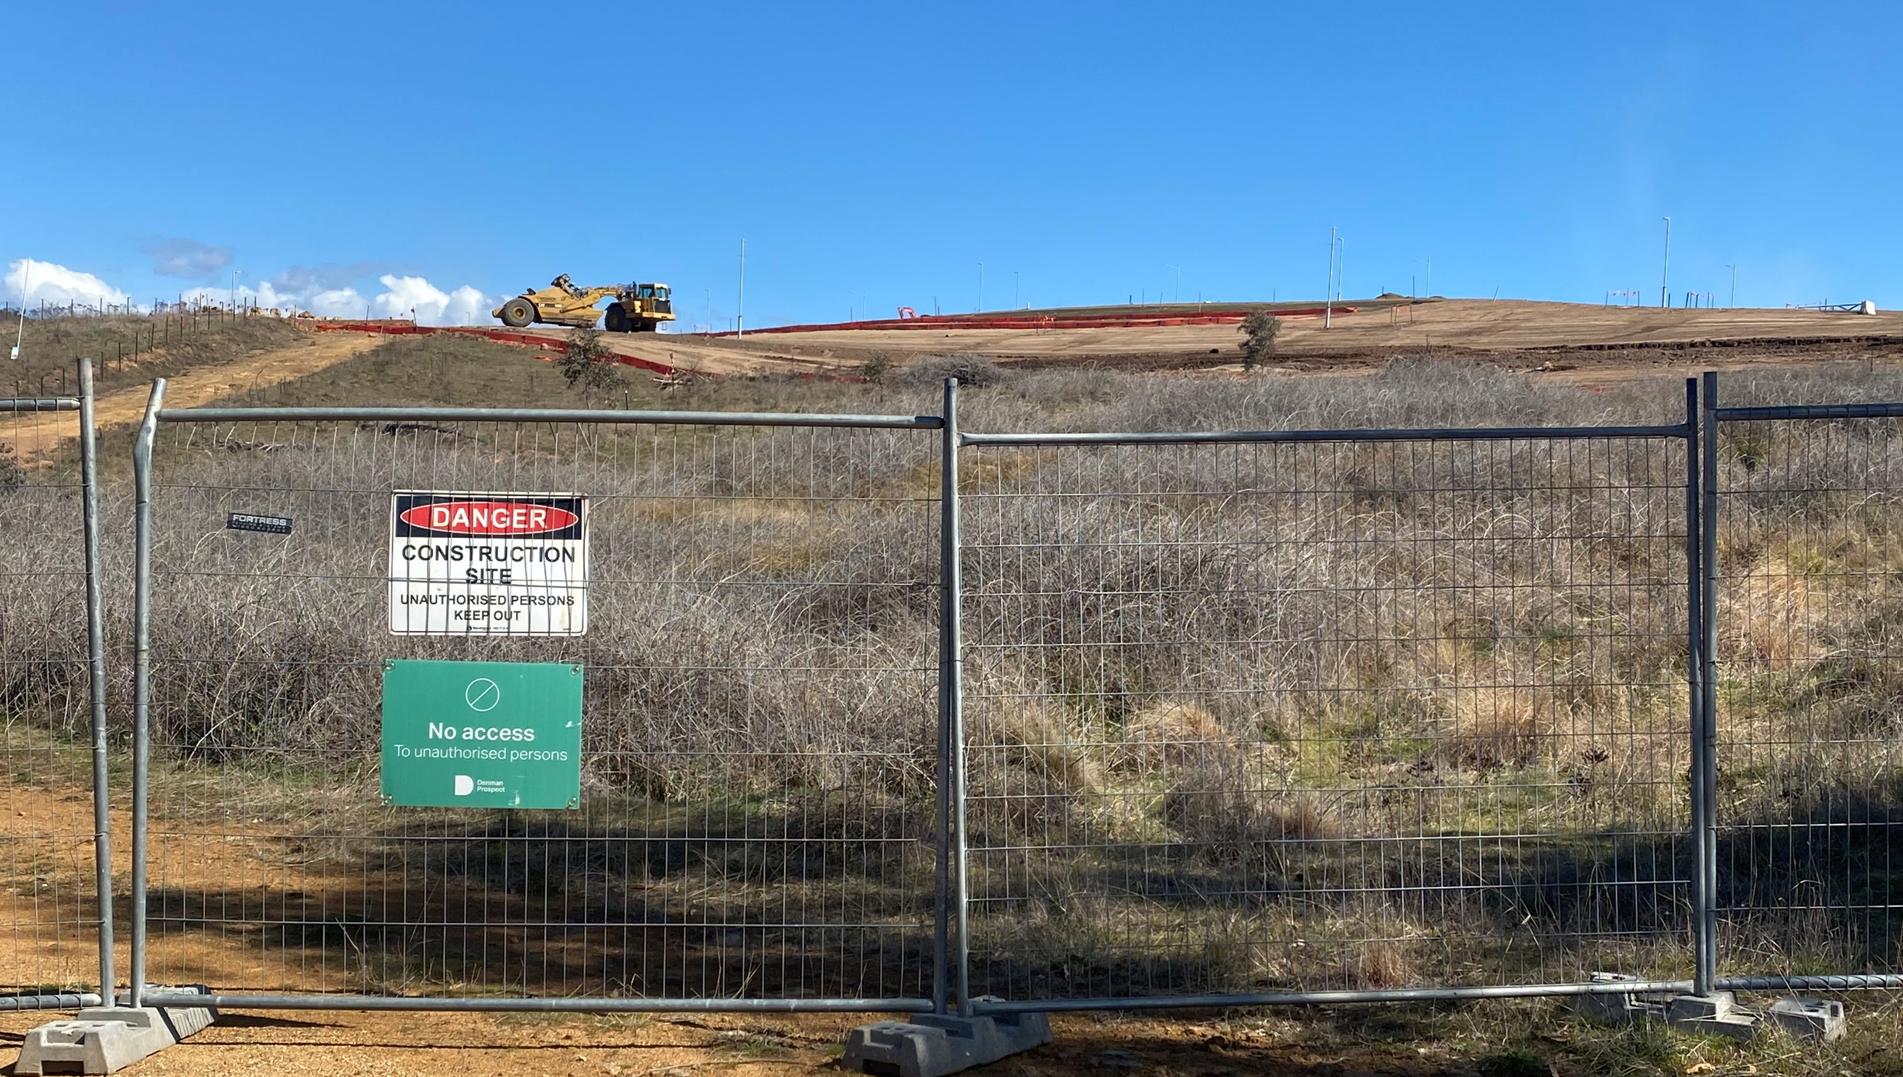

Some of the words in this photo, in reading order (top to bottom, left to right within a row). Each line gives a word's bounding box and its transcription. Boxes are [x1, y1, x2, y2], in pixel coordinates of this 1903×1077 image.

[232, 514, 287, 526] FORTRESS
[432, 507, 548, 529] DANGER
[402, 544, 575, 562] CONSTRUCTION
[465, 567, 512, 585] SITE
[400, 594, 507, 606] UNAUTHORISED
[510, 595, 575, 606] PERSONS
[454, 610, 490, 621] KEEP
[493, 610, 522, 621] OUT
[428, 722, 457, 740] No
[461, 727, 535, 742] access
[394, 744, 411, 758] To
[414, 746, 507, 760] unauthorised
[510, 750, 568, 762] persons
